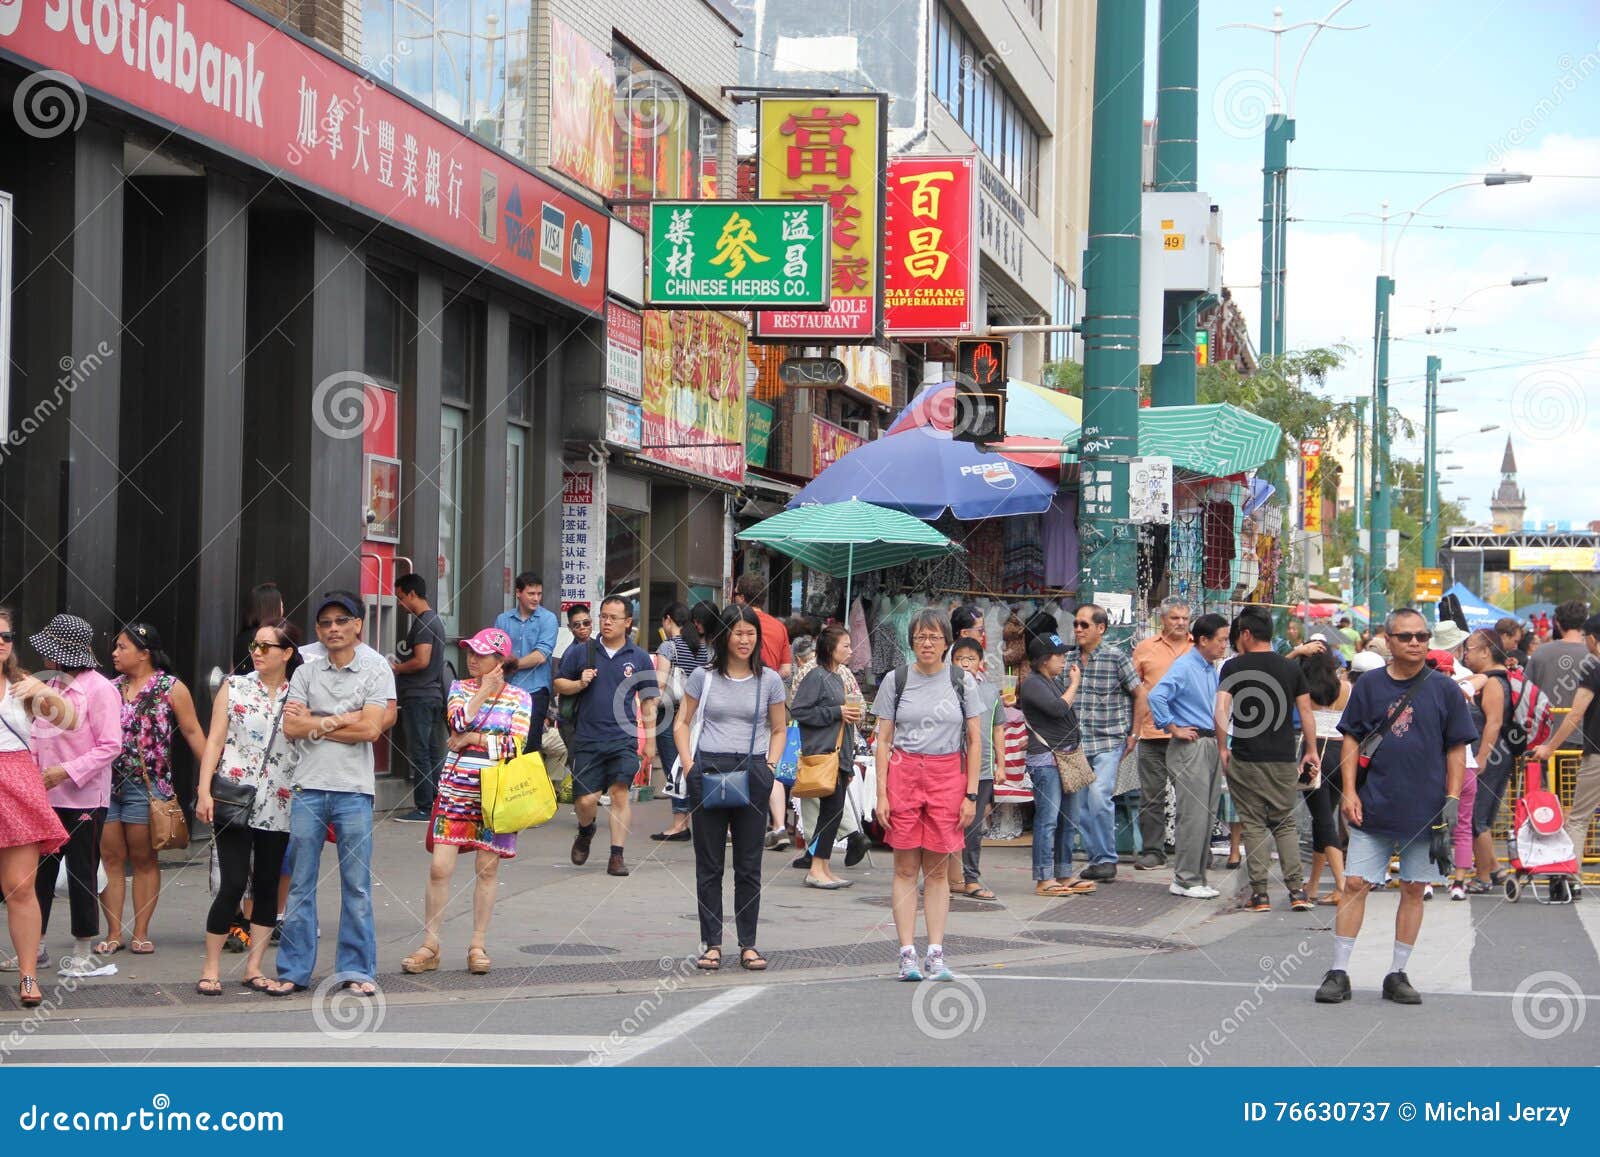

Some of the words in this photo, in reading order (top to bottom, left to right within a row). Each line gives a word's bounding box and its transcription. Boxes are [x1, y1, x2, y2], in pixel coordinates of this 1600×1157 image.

[899, 170, 955, 281] 百昌
[545, 224, 560, 254] VISA
[1164, 237, 1179, 248] 49
[665, 279, 728, 296] CHINESE
[731, 280, 780, 296] HERBS
[783, 280, 810, 296] CO.
[885, 288, 913, 298] BAI
[915, 288, 965, 298] CHANG
[884, 297, 966, 307] SUPERMARKET
[773, 313, 861, 329] RESTAURANT
[960, 461, 1010, 477] PEPSI
